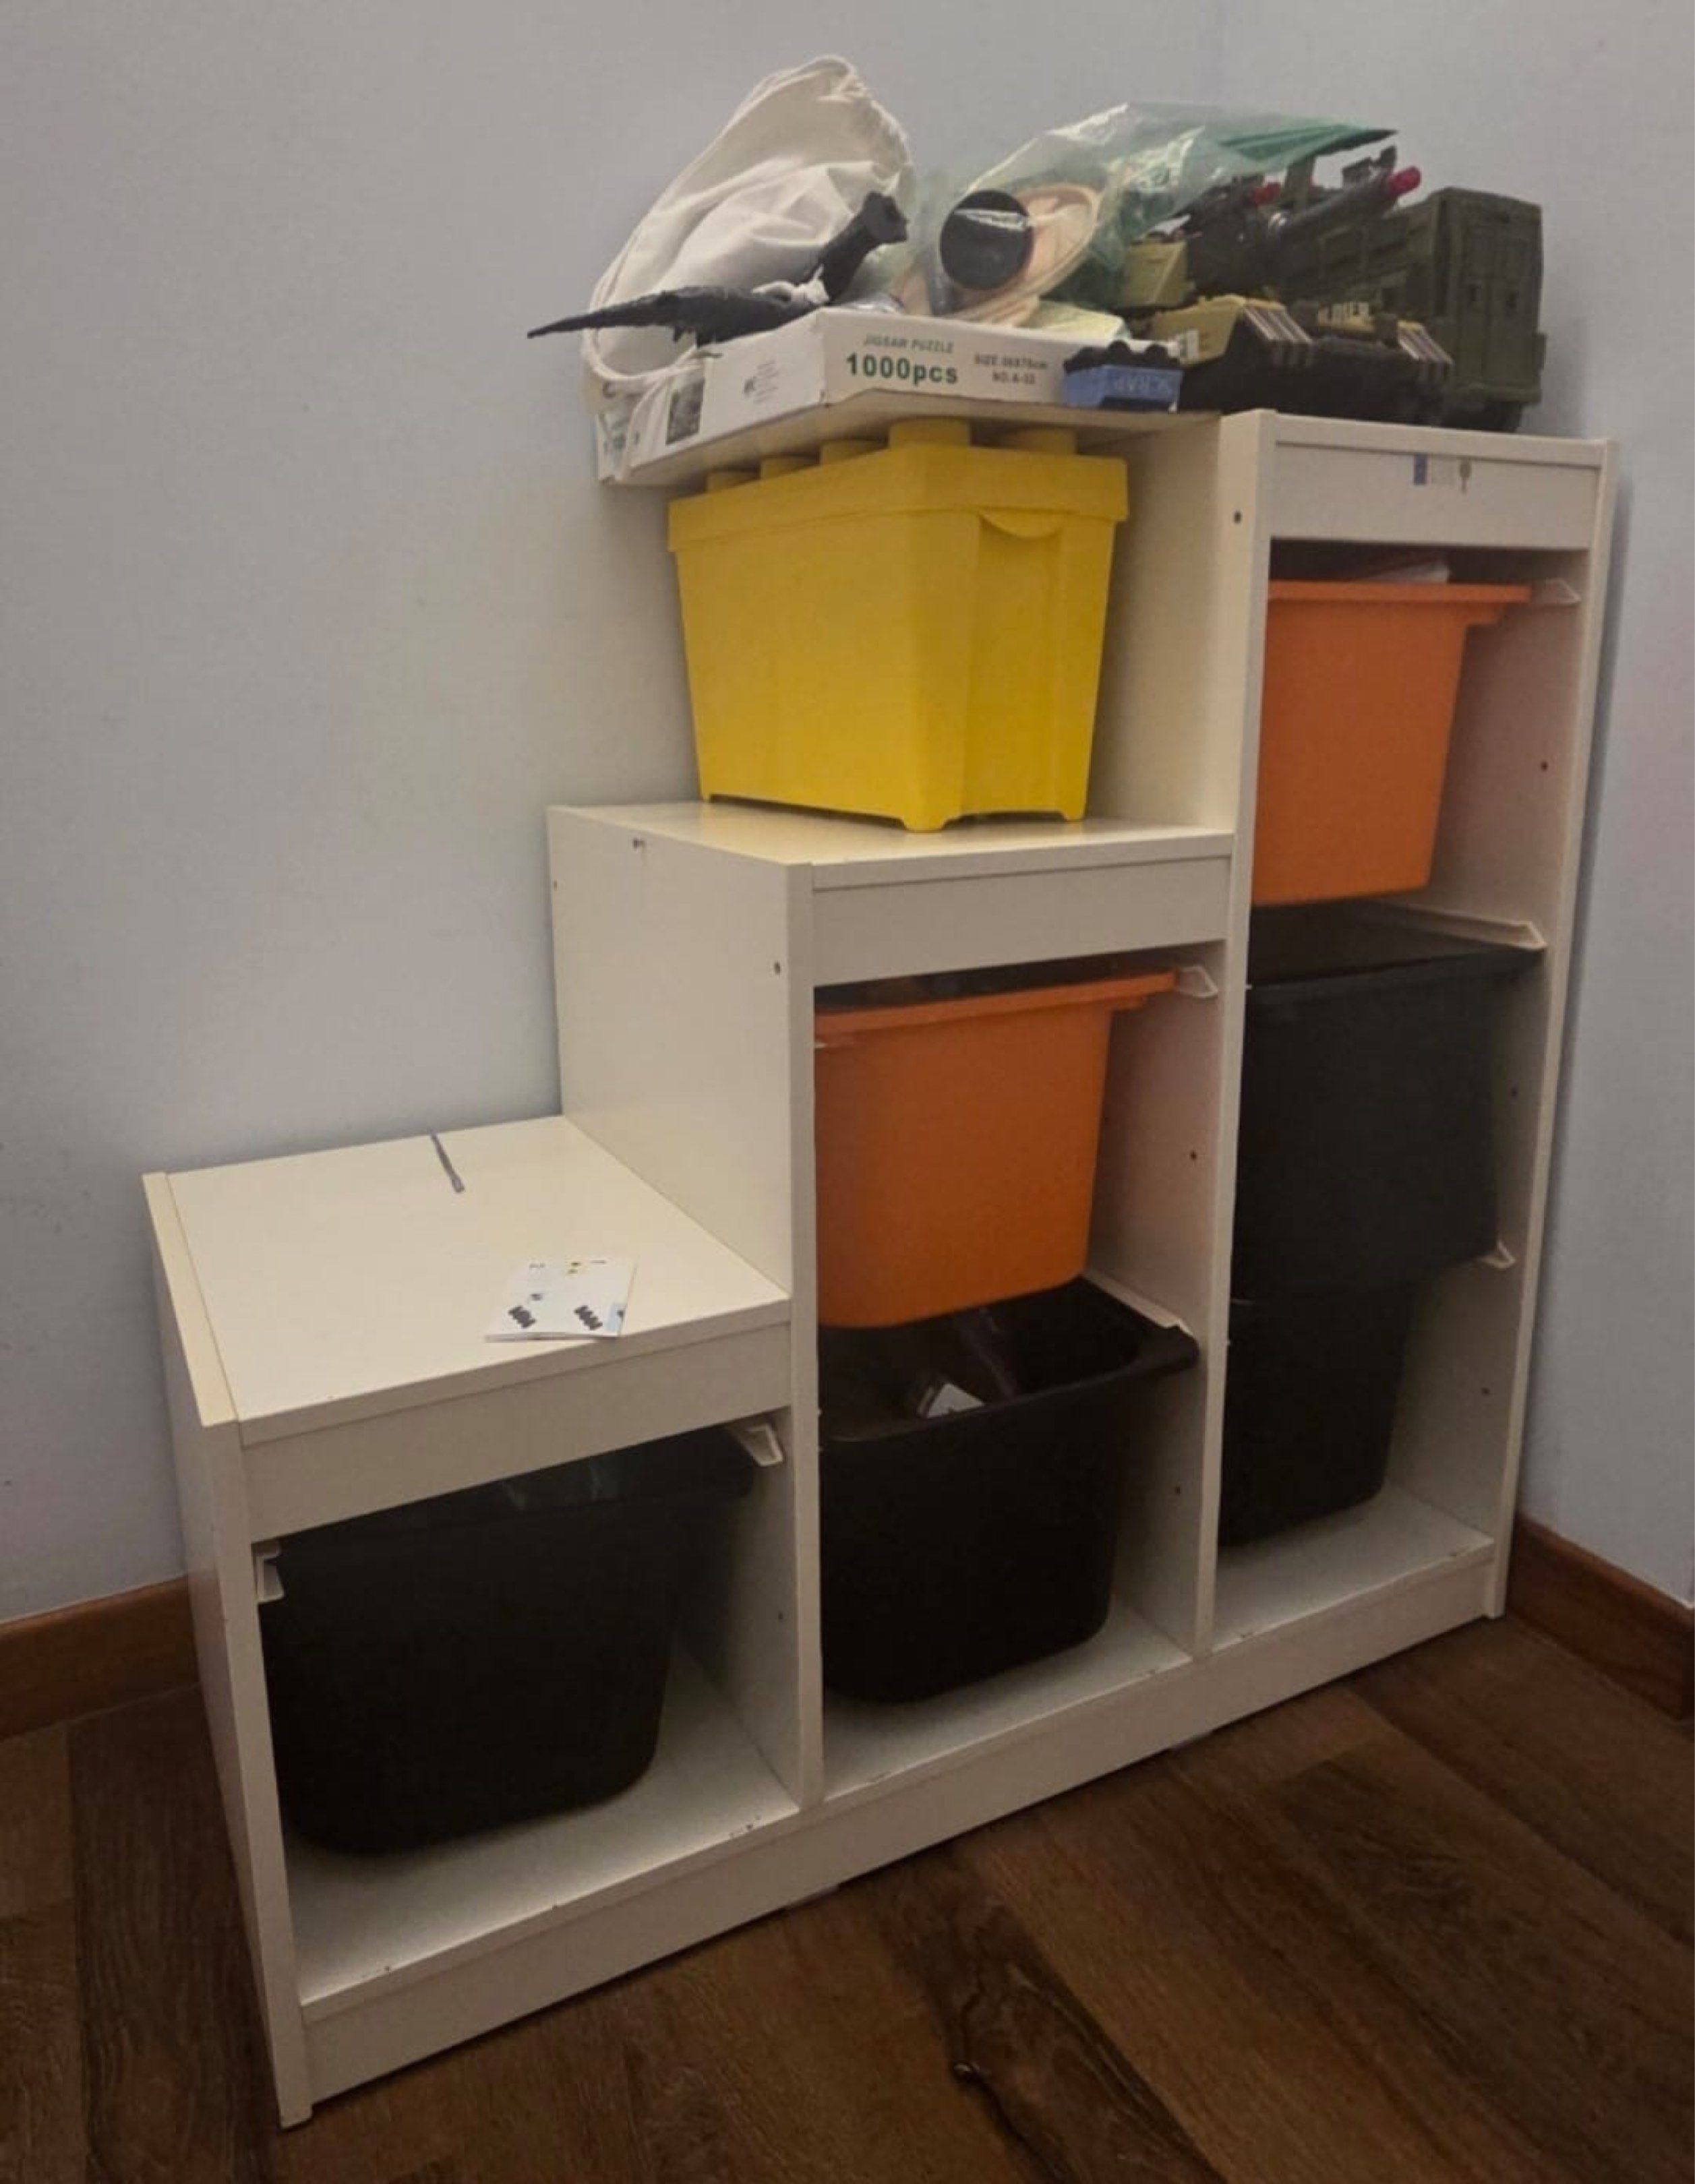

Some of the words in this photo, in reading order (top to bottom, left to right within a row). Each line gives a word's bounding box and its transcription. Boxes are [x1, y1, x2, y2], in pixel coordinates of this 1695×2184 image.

[864, 334, 908, 348] JIGSAW
[912, 338, 955, 354] PUZZLE
[846, 352, 958, 388] 1000pcs
